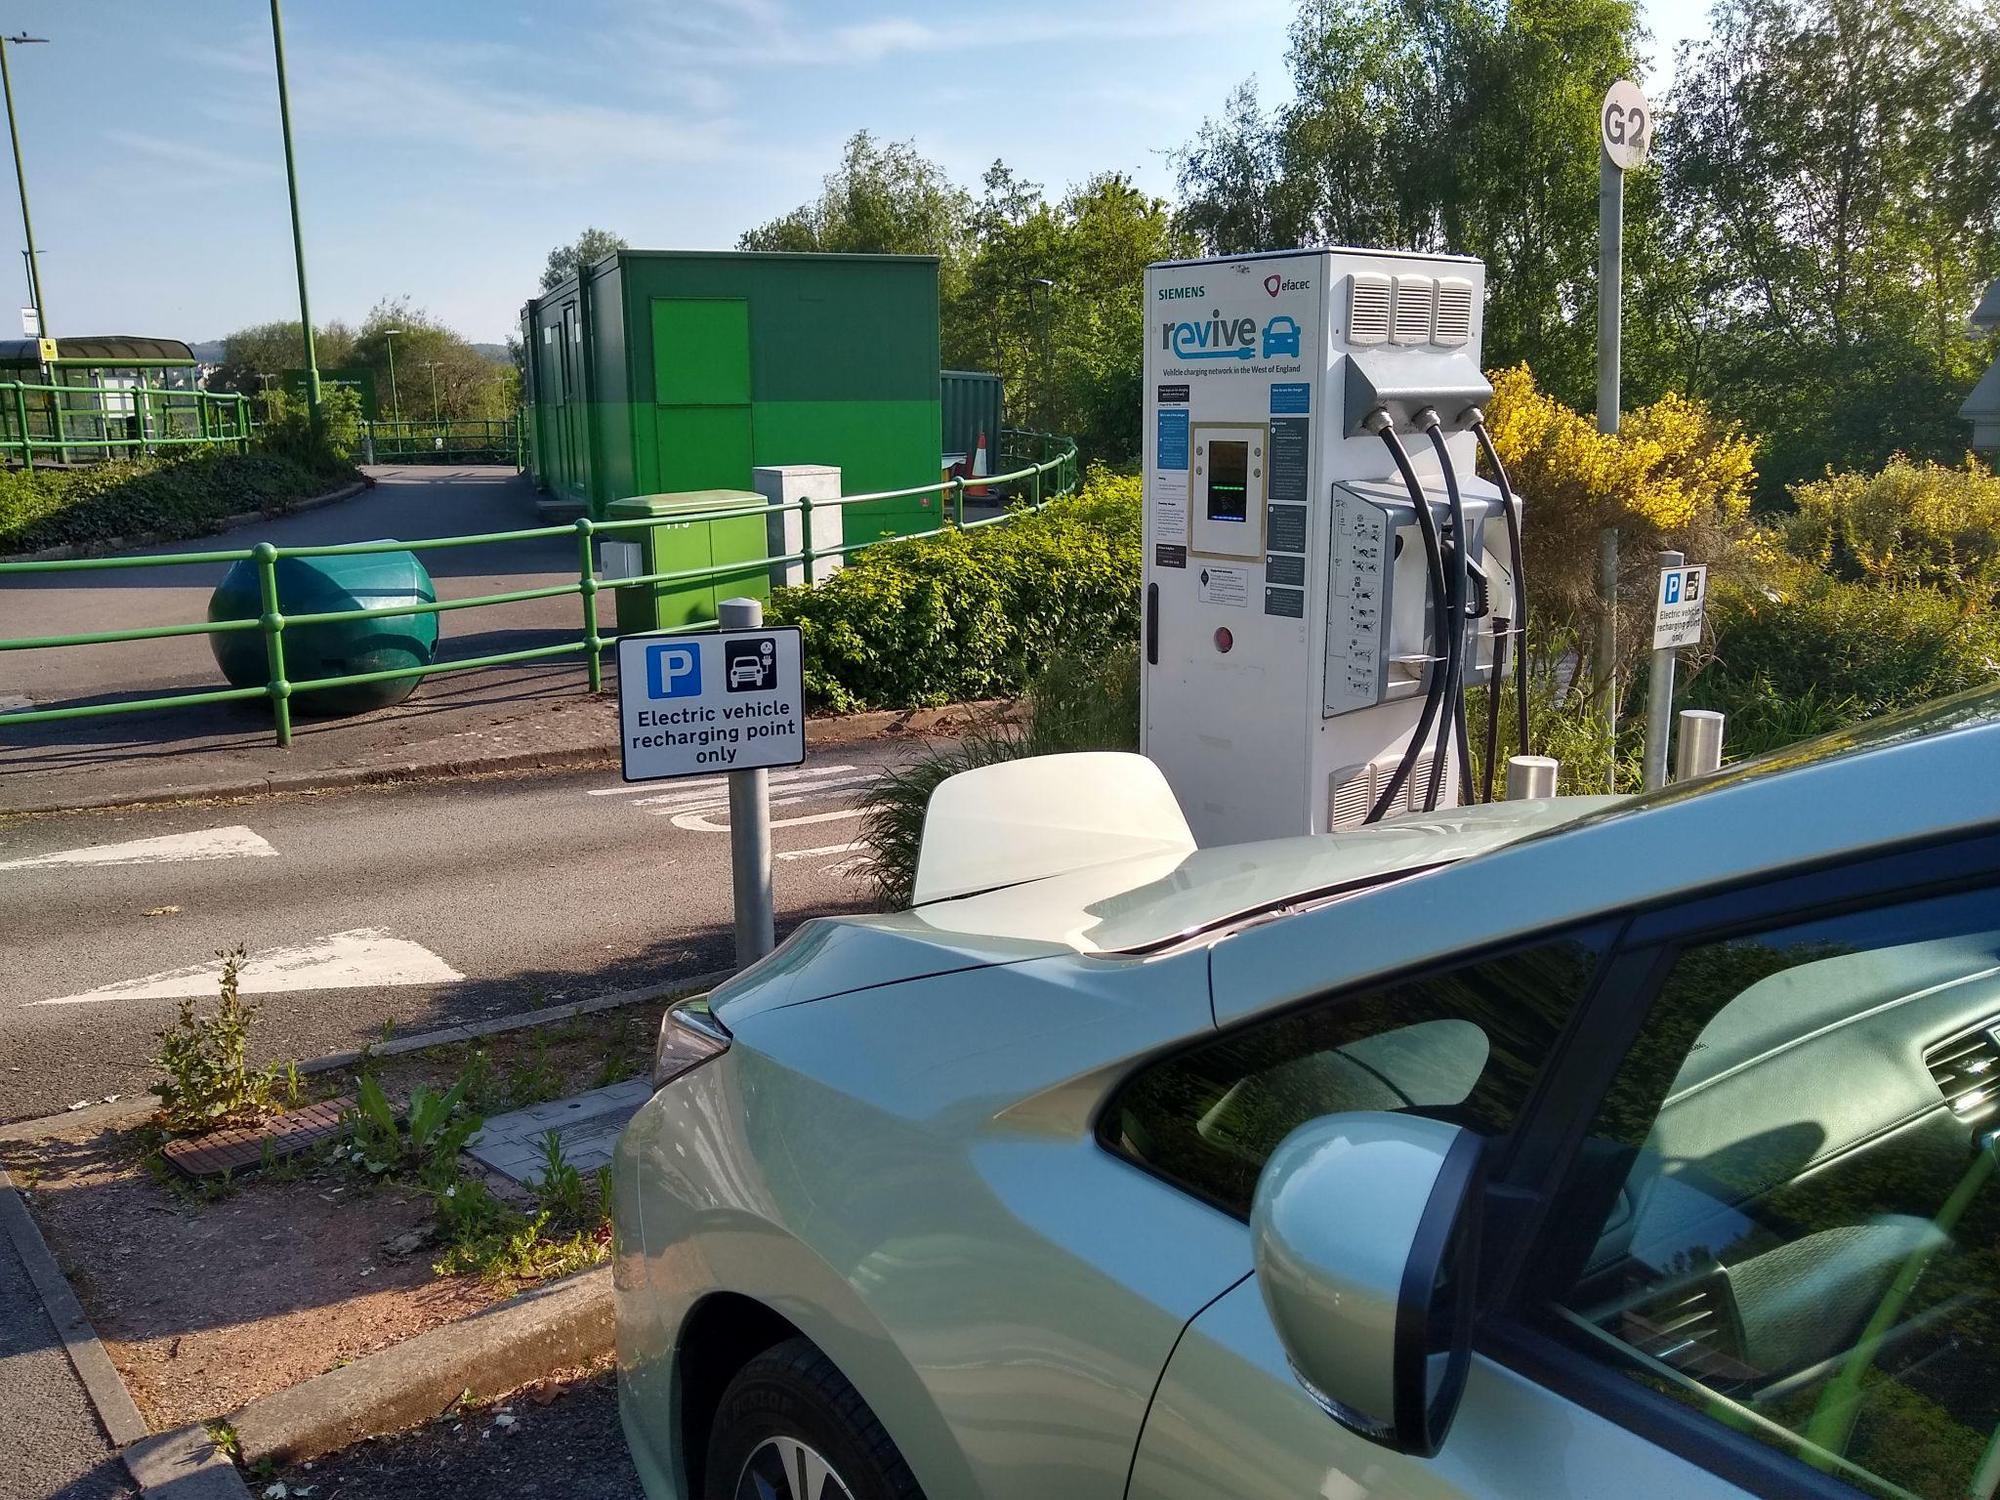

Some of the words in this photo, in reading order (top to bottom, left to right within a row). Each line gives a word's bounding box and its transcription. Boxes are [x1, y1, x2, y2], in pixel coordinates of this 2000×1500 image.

[1605, 102, 1645, 147] G2
[1158, 285, 1205, 301] SIEMENS
[1281, 278, 1310, 292] efacec
[1162, 309, 1257, 359] revive
[1184, 366, 1208, 377] charging
[1209, 365, 1233, 375] network
[1240, 365, 1250, 374] the
[1251, 365, 1267, 374] West
[1268, 364, 1275, 373] of
[1276, 364, 1301, 375] England
[1669, 577, 1679, 601] P
[1660, 609, 1681, 620] Electric
[660, 650, 693, 693] P
[638, 706, 716, 727] Electric
[723, 700, 790, 720] vehicle
[632, 726, 739, 749] recharging
[747, 719, 796, 741] point
[696, 746, 737, 764] only
